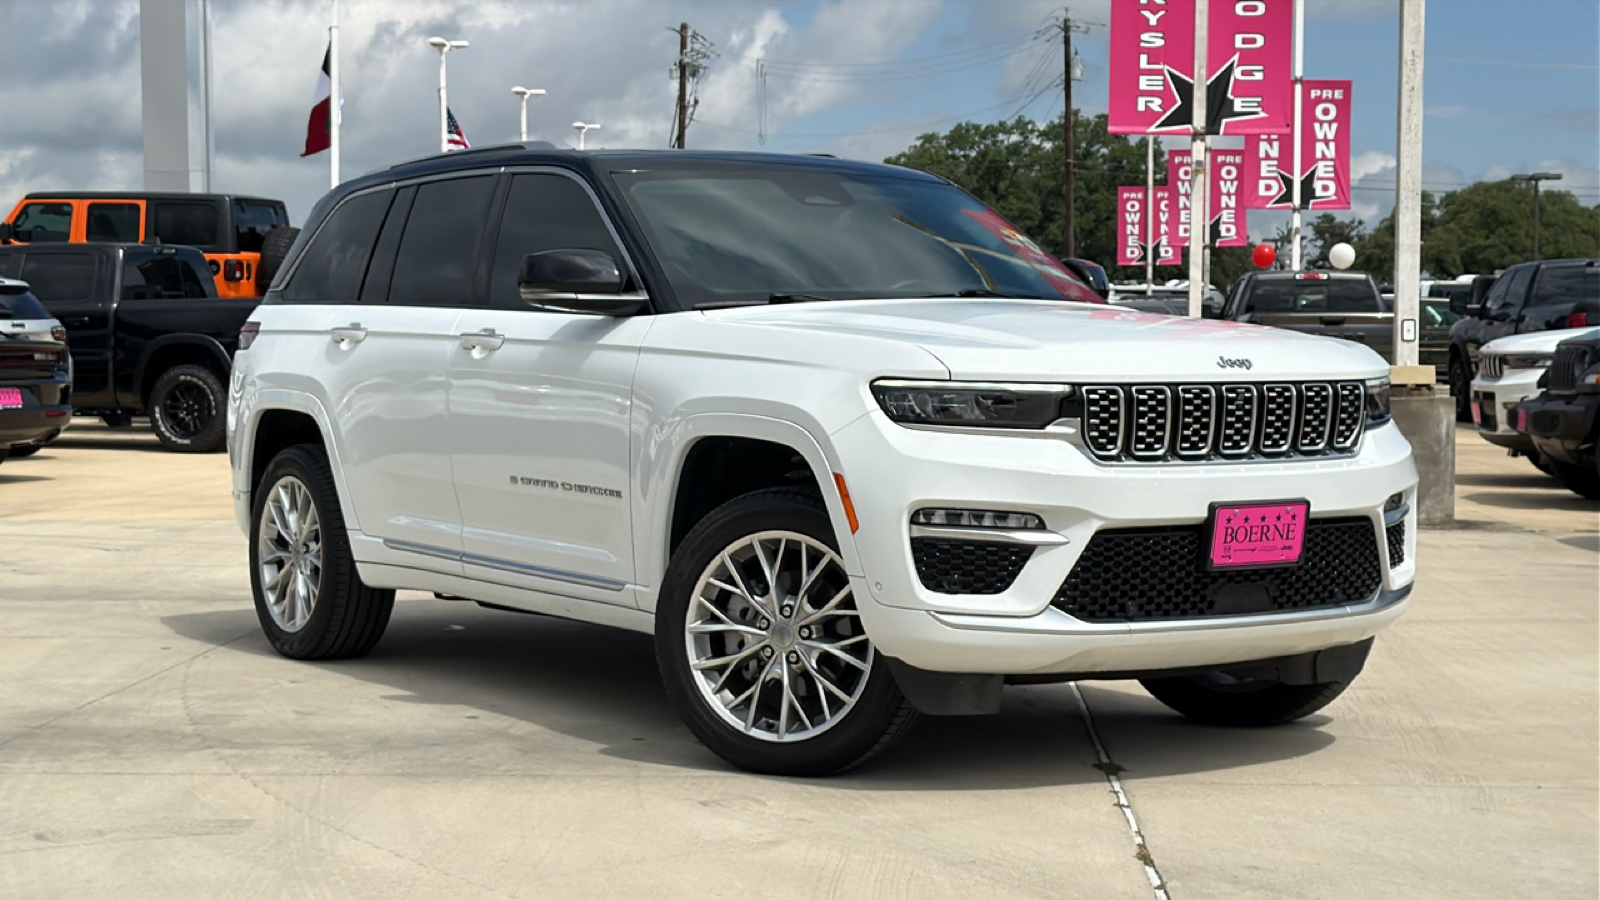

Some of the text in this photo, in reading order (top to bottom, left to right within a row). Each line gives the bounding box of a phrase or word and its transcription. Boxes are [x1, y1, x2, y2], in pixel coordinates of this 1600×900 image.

[1137, 0, 1167, 112] YSLER
[1310, 89, 1344, 99] PRE
[1174, 155, 1191, 164] PR
[1217, 155, 1242, 164] PRE
[1258, 134, 1280, 196] NED
[1313, 102, 1338, 197] OWNED
[1219, 165, 1238, 237] OWNED
[1125, 200, 1141, 258] OWNED
[1216, 355, 1253, 371] Jeep
[1223, 523, 1297, 545] BOERNE
